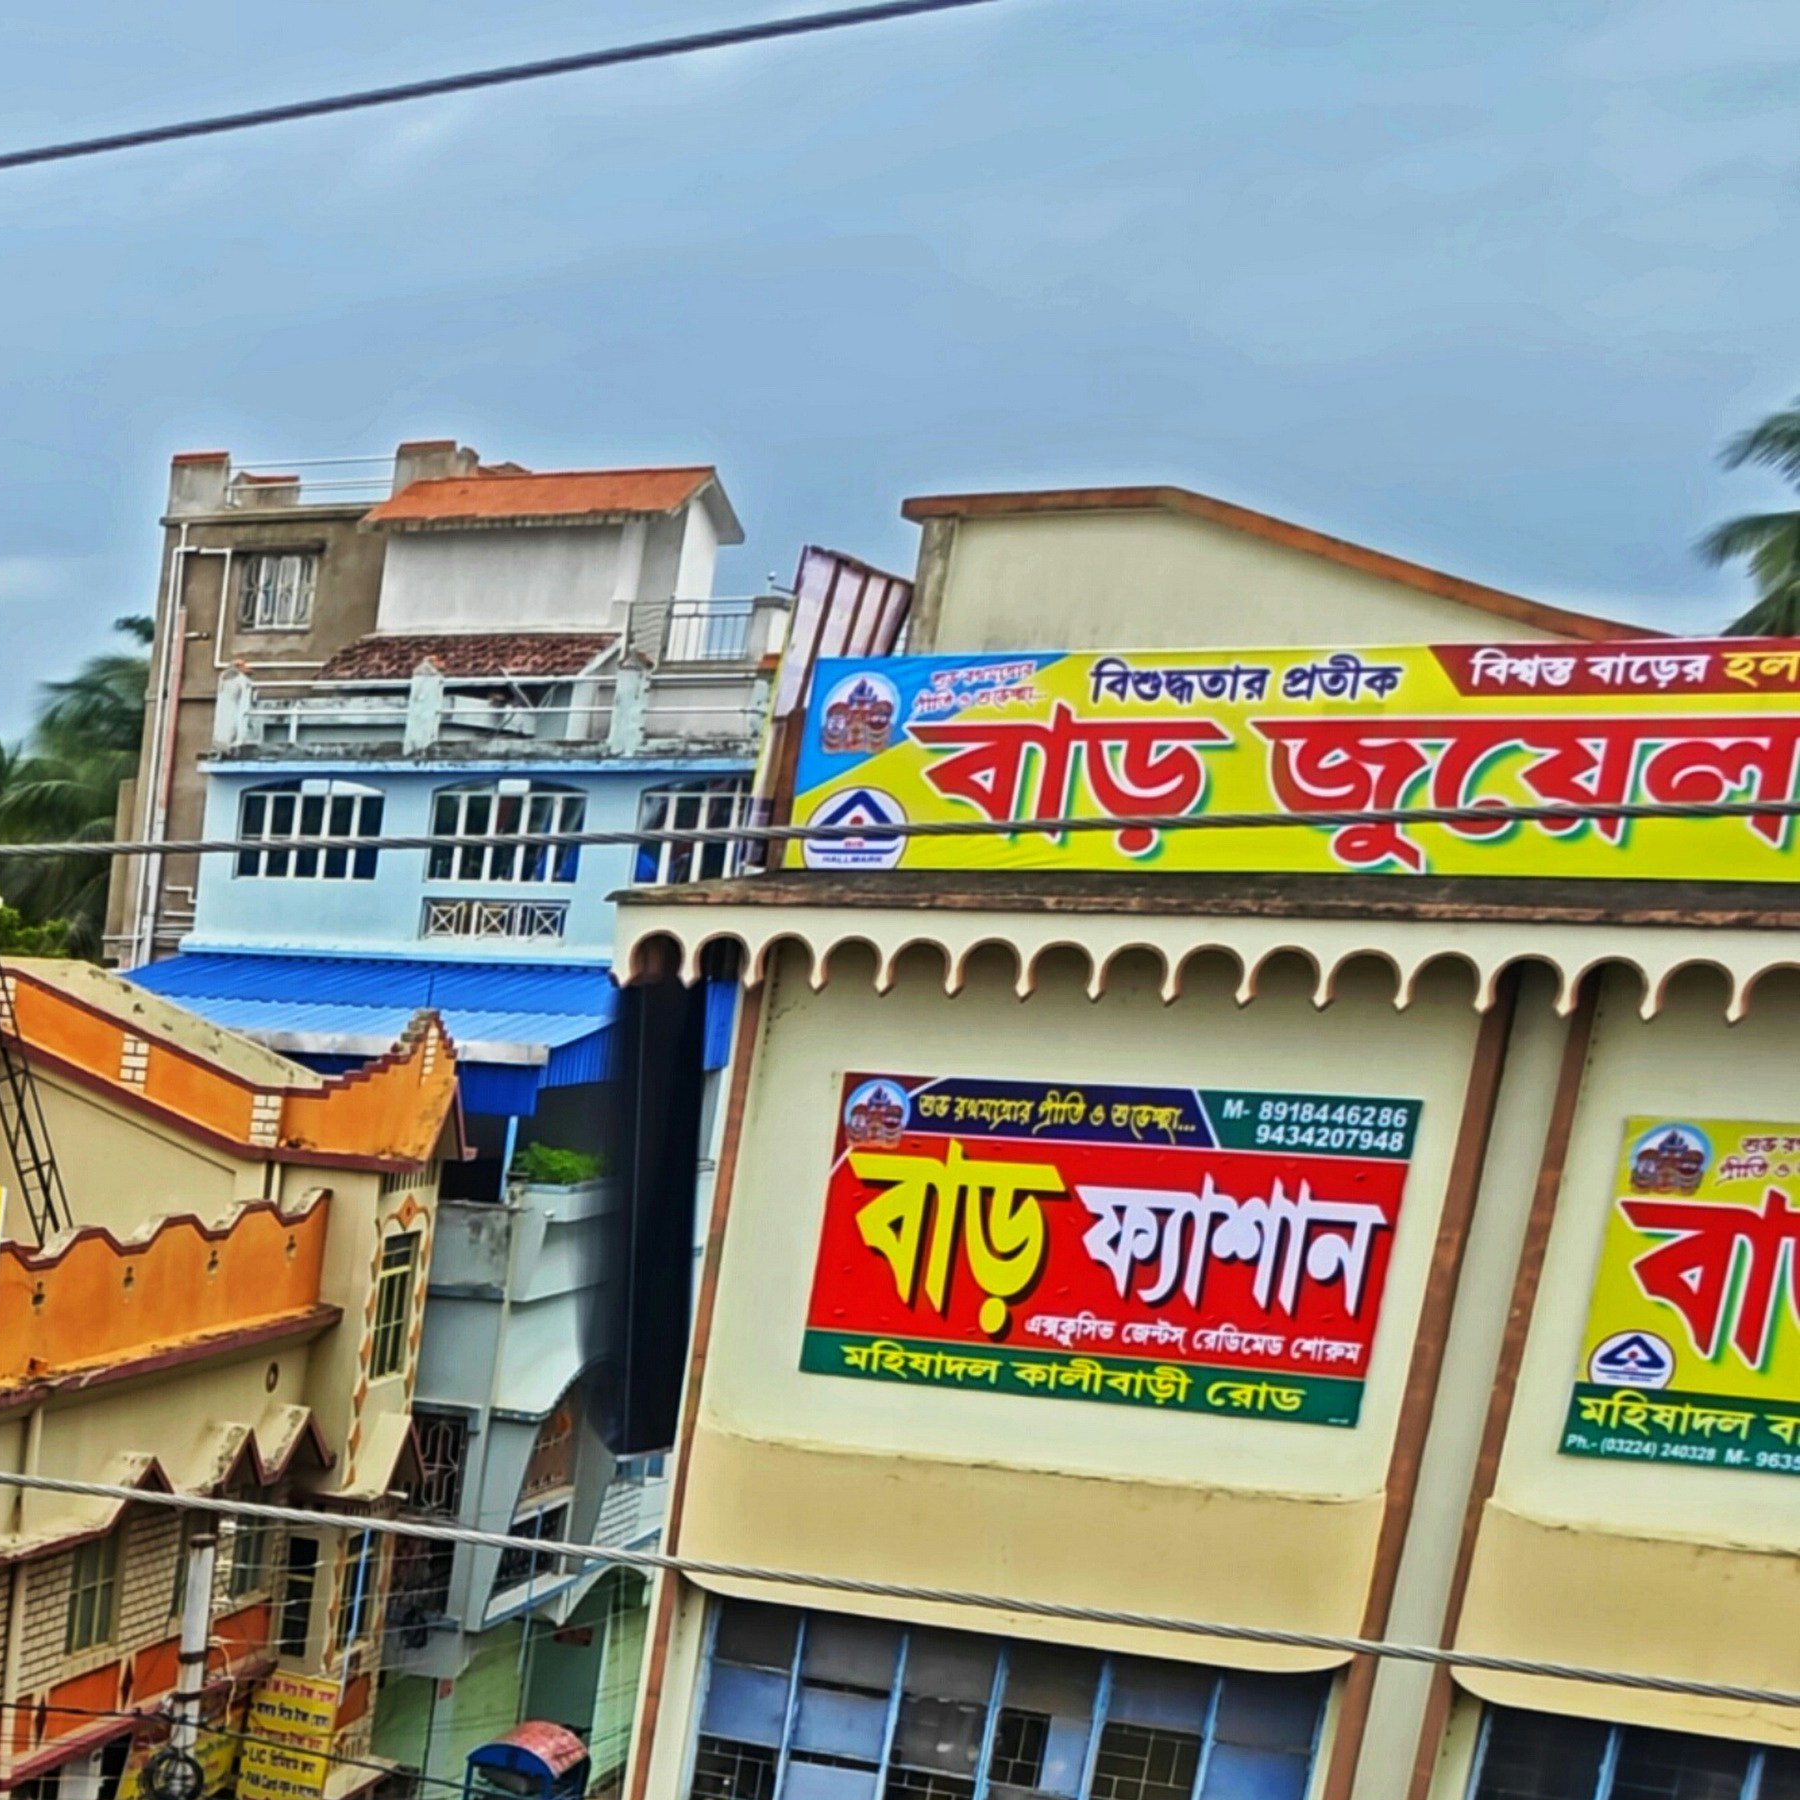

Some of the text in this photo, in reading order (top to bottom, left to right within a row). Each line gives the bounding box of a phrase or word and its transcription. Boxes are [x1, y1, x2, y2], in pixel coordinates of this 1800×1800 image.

[1090, 653, 1402, 705] বিশুদ্ধতার প্রতীক
[1470, 648, 1576, 688] বিশ্বস্ত
[1588, 653, 1711, 690] বাড়ের
[907, 702, 1230, 856] বাড়
[821, 854, 883, 864] HALLMARK
[918, 1093, 952, 1119] শুভ
[1032, 1091, 1087, 1134] প্রীতি
[1089, 1107, 1106, 1126] ও
[1222, 1099, 1409, 1129] M- 8918446286
[1255, 1124, 1405, 1152] 9434207948
[846, 1140, 1389, 1334] বাড় ফ্যাশান
[1192, 1325, 1283, 1358] রেডিমেড
[1289, 1333, 1361, 1364] শোরুম
[840, 1339, 1307, 1412] মহিষাদল কালীবাড়ী রোড
[1577, 1389, 1800, 1446] মহিষাদল ব
[1600, 1437, 1658, 1460] (03224)
[1659, 1444, 1717, 1462] 240328
